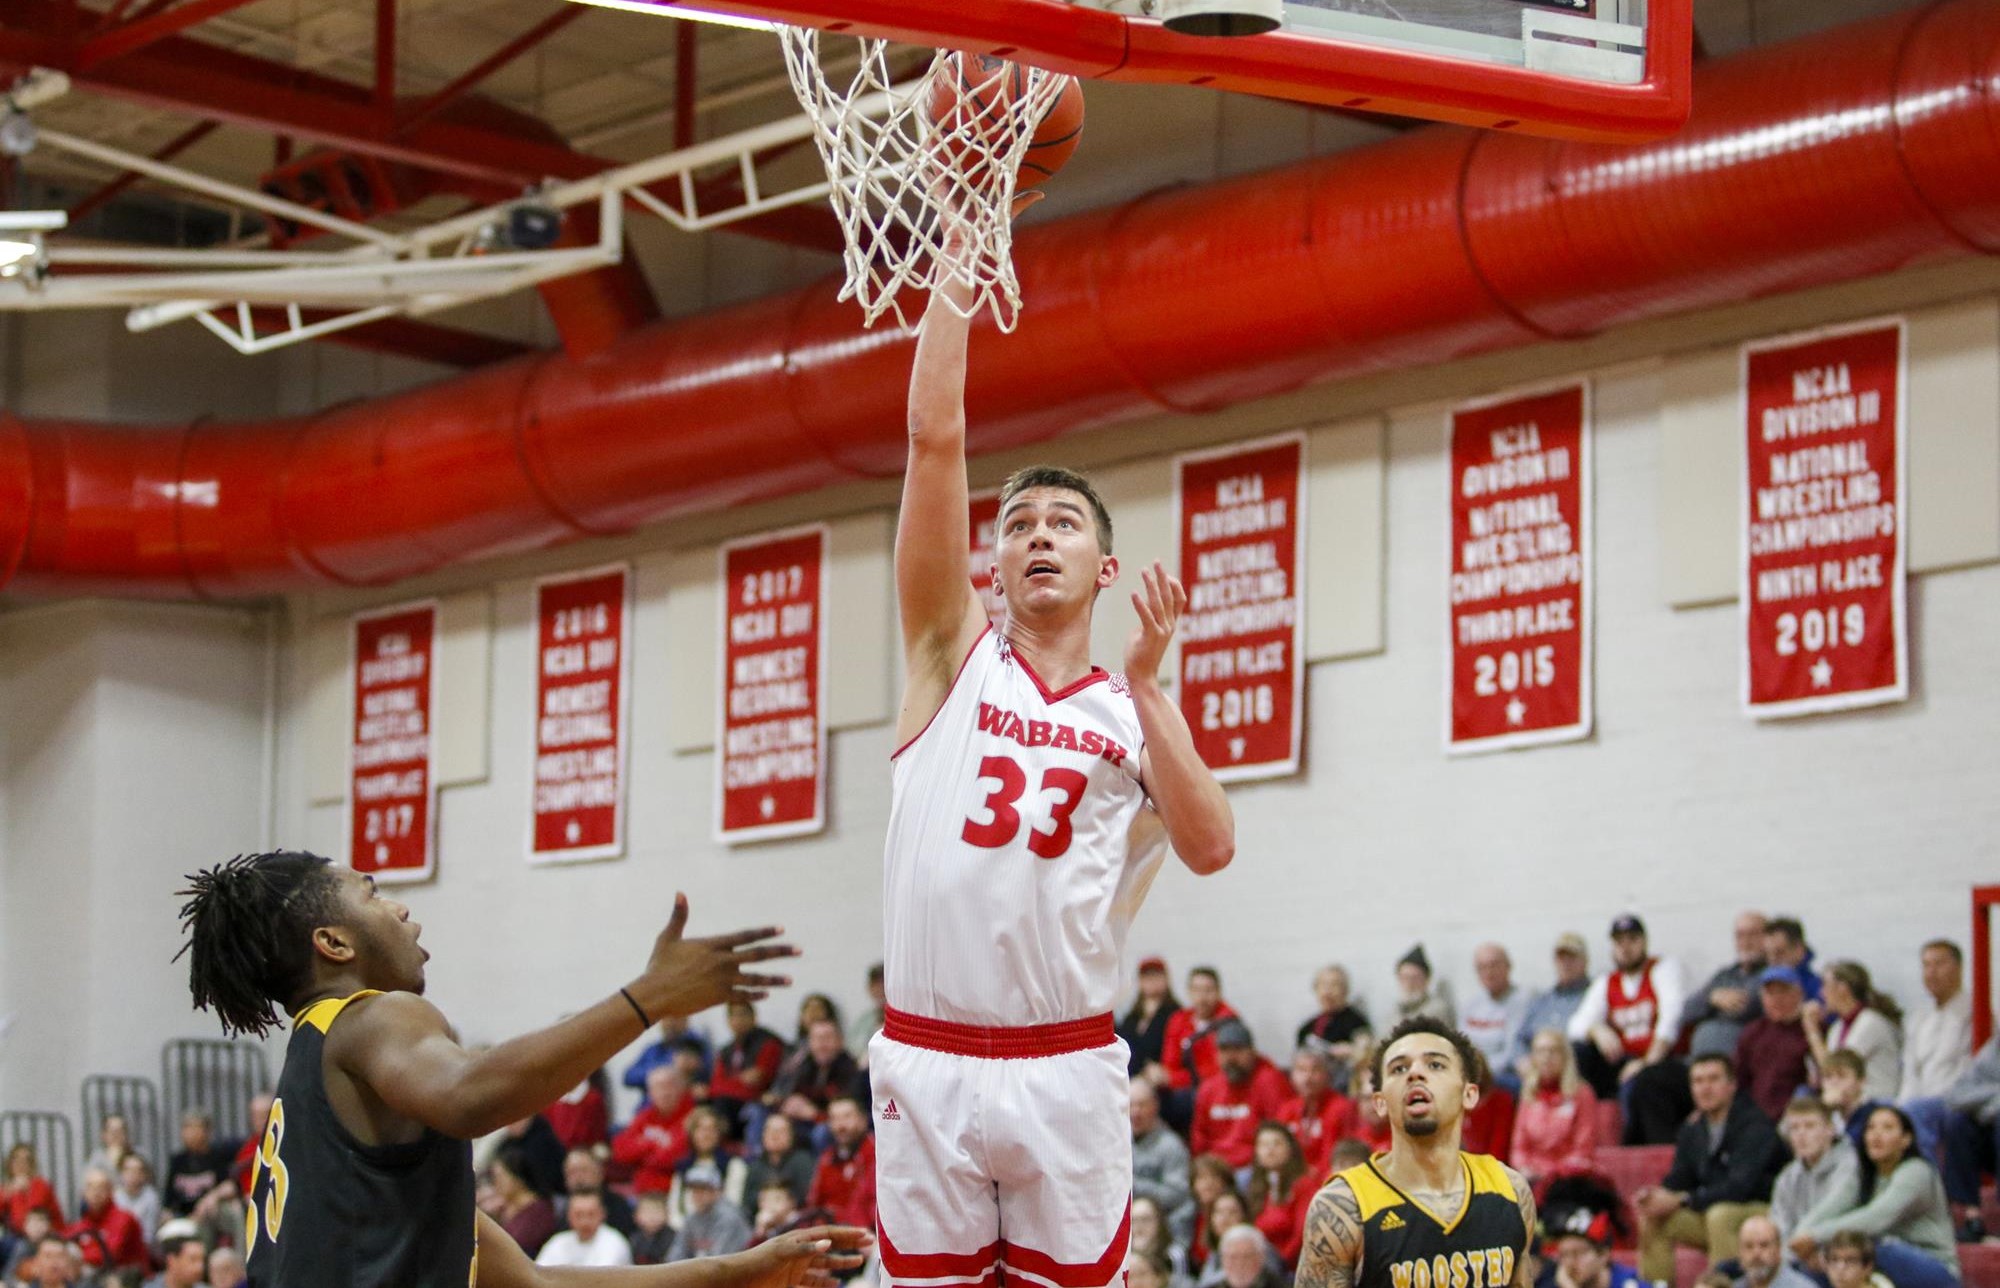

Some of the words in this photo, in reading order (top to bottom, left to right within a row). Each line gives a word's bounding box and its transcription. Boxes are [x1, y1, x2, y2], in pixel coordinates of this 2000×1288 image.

[1795, 364, 1849, 401] NCAA
[1764, 397, 1855, 442] DIVISION
[1860, 393, 1879, 423] III
[1464, 453, 1544, 497] DIVISION
[1772, 441, 1867, 484] NATIONAL
[1470, 494, 1562, 536] NATIONAL
[1760, 472, 1879, 518] WRESTLING
[1465, 524, 1570, 569] WRESTLING
[1753, 505, 1892, 555] CHAMPIONSHIPS
[1760, 564, 1816, 601] NINTH
[1823, 555, 1881, 592] PLACE
[1516, 601, 1572, 638] PLACE
[1777, 605, 1863, 655] 2019
[1476, 647, 1553, 696] 2015
[1204, 686, 1272, 730] 2016
[978, 702, 1127, 767] WABASH
[962, 758, 1087, 858] 33
